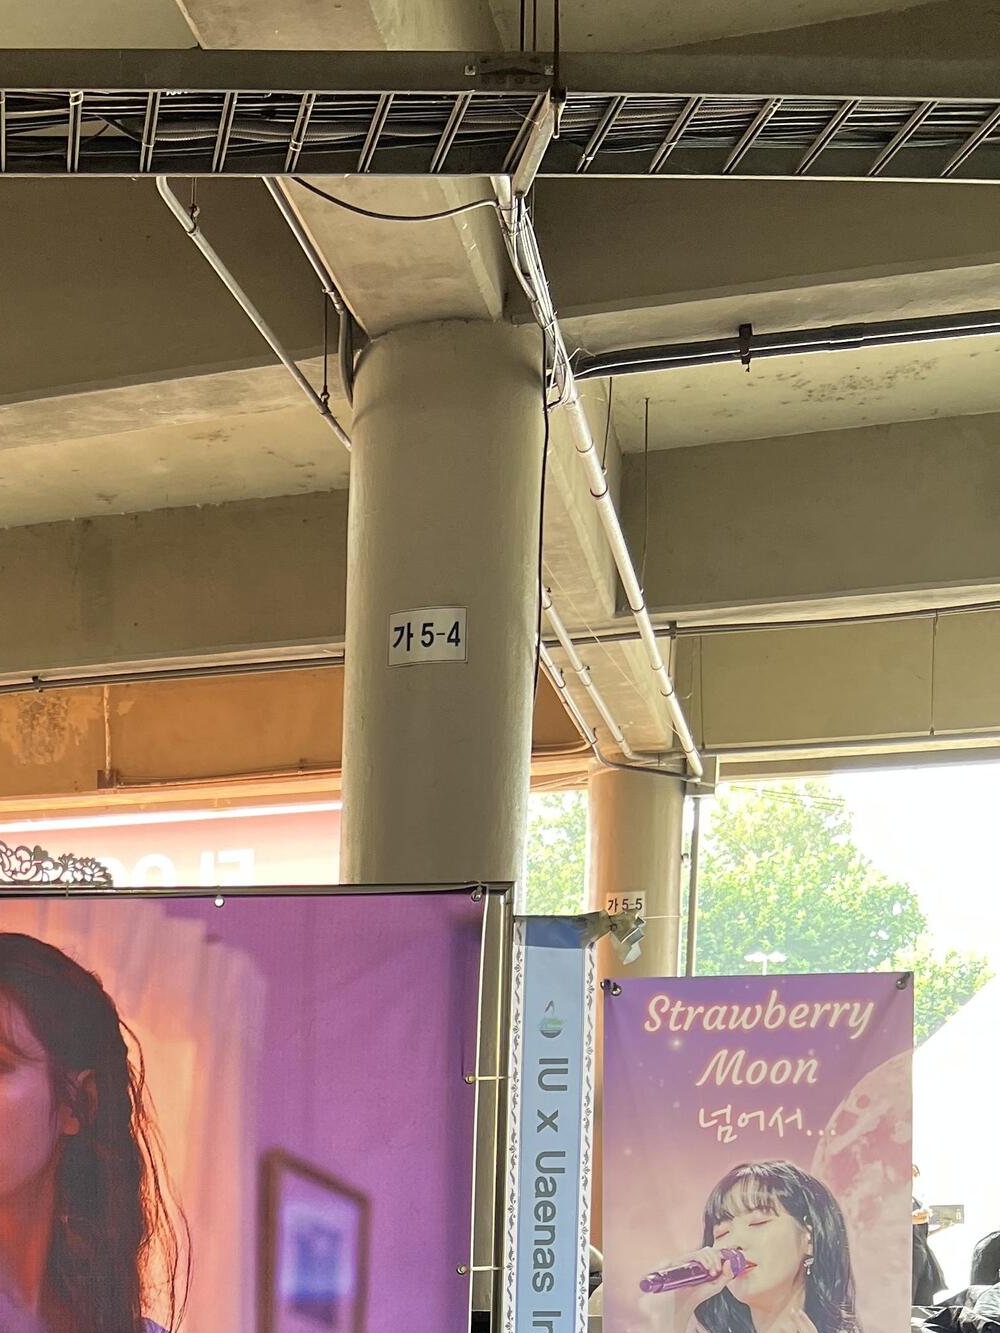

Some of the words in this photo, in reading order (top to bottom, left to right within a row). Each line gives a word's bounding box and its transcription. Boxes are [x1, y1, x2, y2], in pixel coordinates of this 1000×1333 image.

[644, 990, 875, 1039] Strawberry
[537, 1058, 569, 1092] IU
[696, 1049, 818, 1086] Moon
[536, 1109, 559, 1133] x
[699, 1104, 837, 1143] 넘어서...
[531, 1151, 566, 1293] Uaenas
